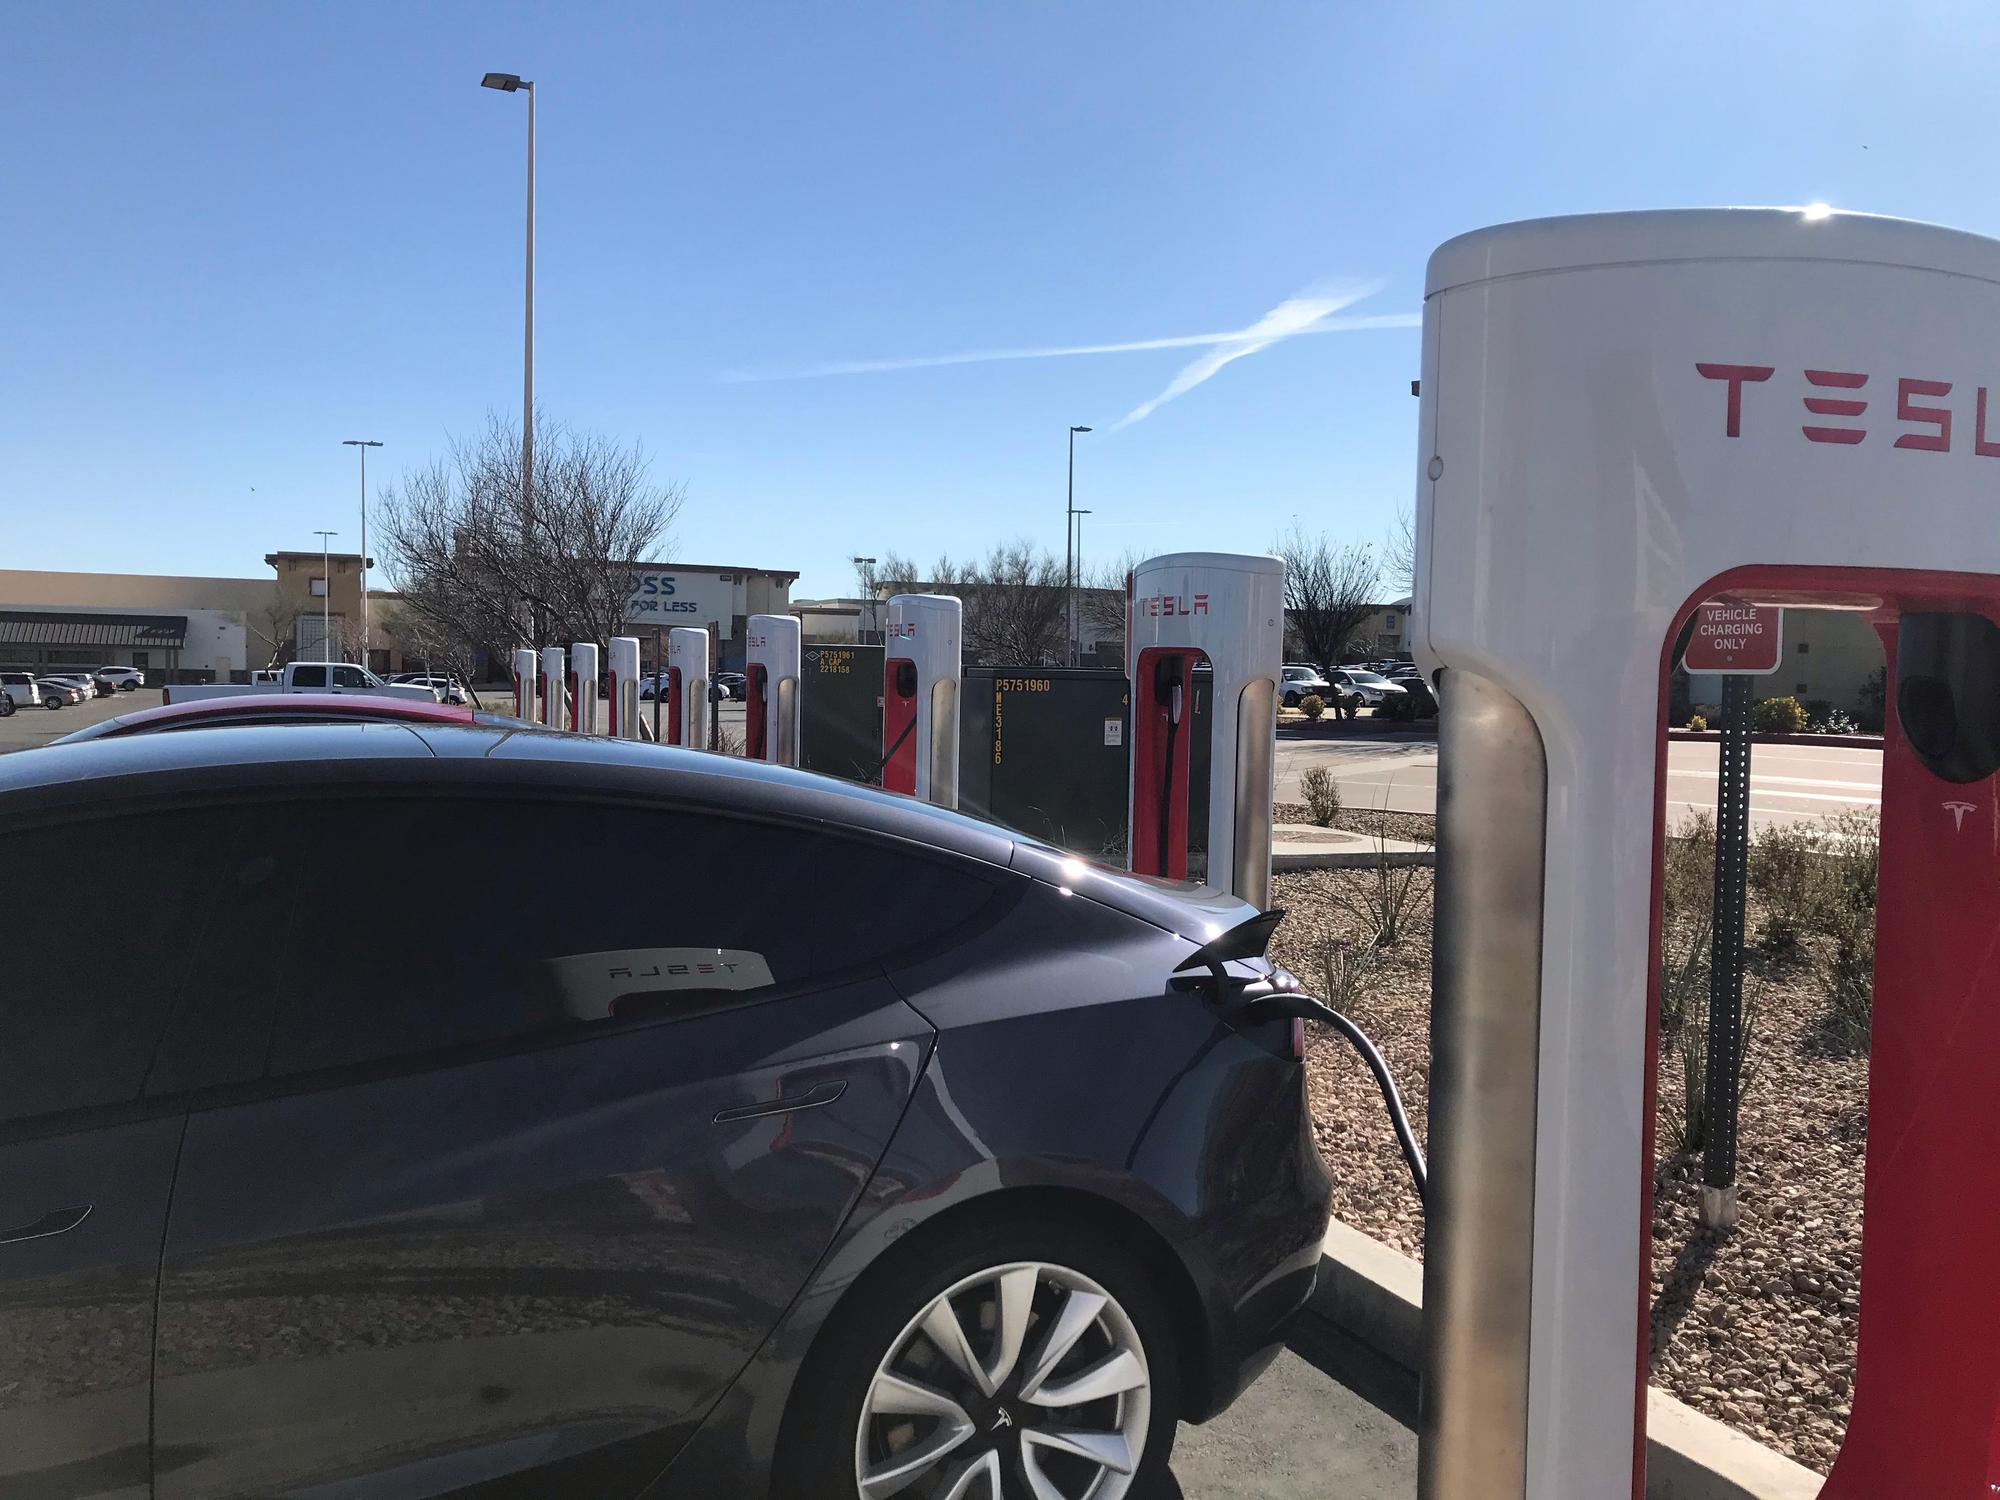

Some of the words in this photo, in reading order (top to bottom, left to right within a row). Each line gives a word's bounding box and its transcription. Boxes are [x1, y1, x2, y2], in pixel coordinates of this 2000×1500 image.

[1695, 363, 2000, 457] TESL
[632, 600, 658, 611] FOR
[664, 601, 697, 613] LESS
[1140, 594, 1208, 617] TESLA
[1707, 608, 1757, 621] VEHICLE
[887, 623, 915, 637] ESLA
[1700, 623, 1763, 636] CHARGING
[1714, 638, 1747, 650] ONLY
[820, 658, 825, 666] A
[828, 658, 842, 666] CAP
[996, 679, 1050, 692] P5751960
